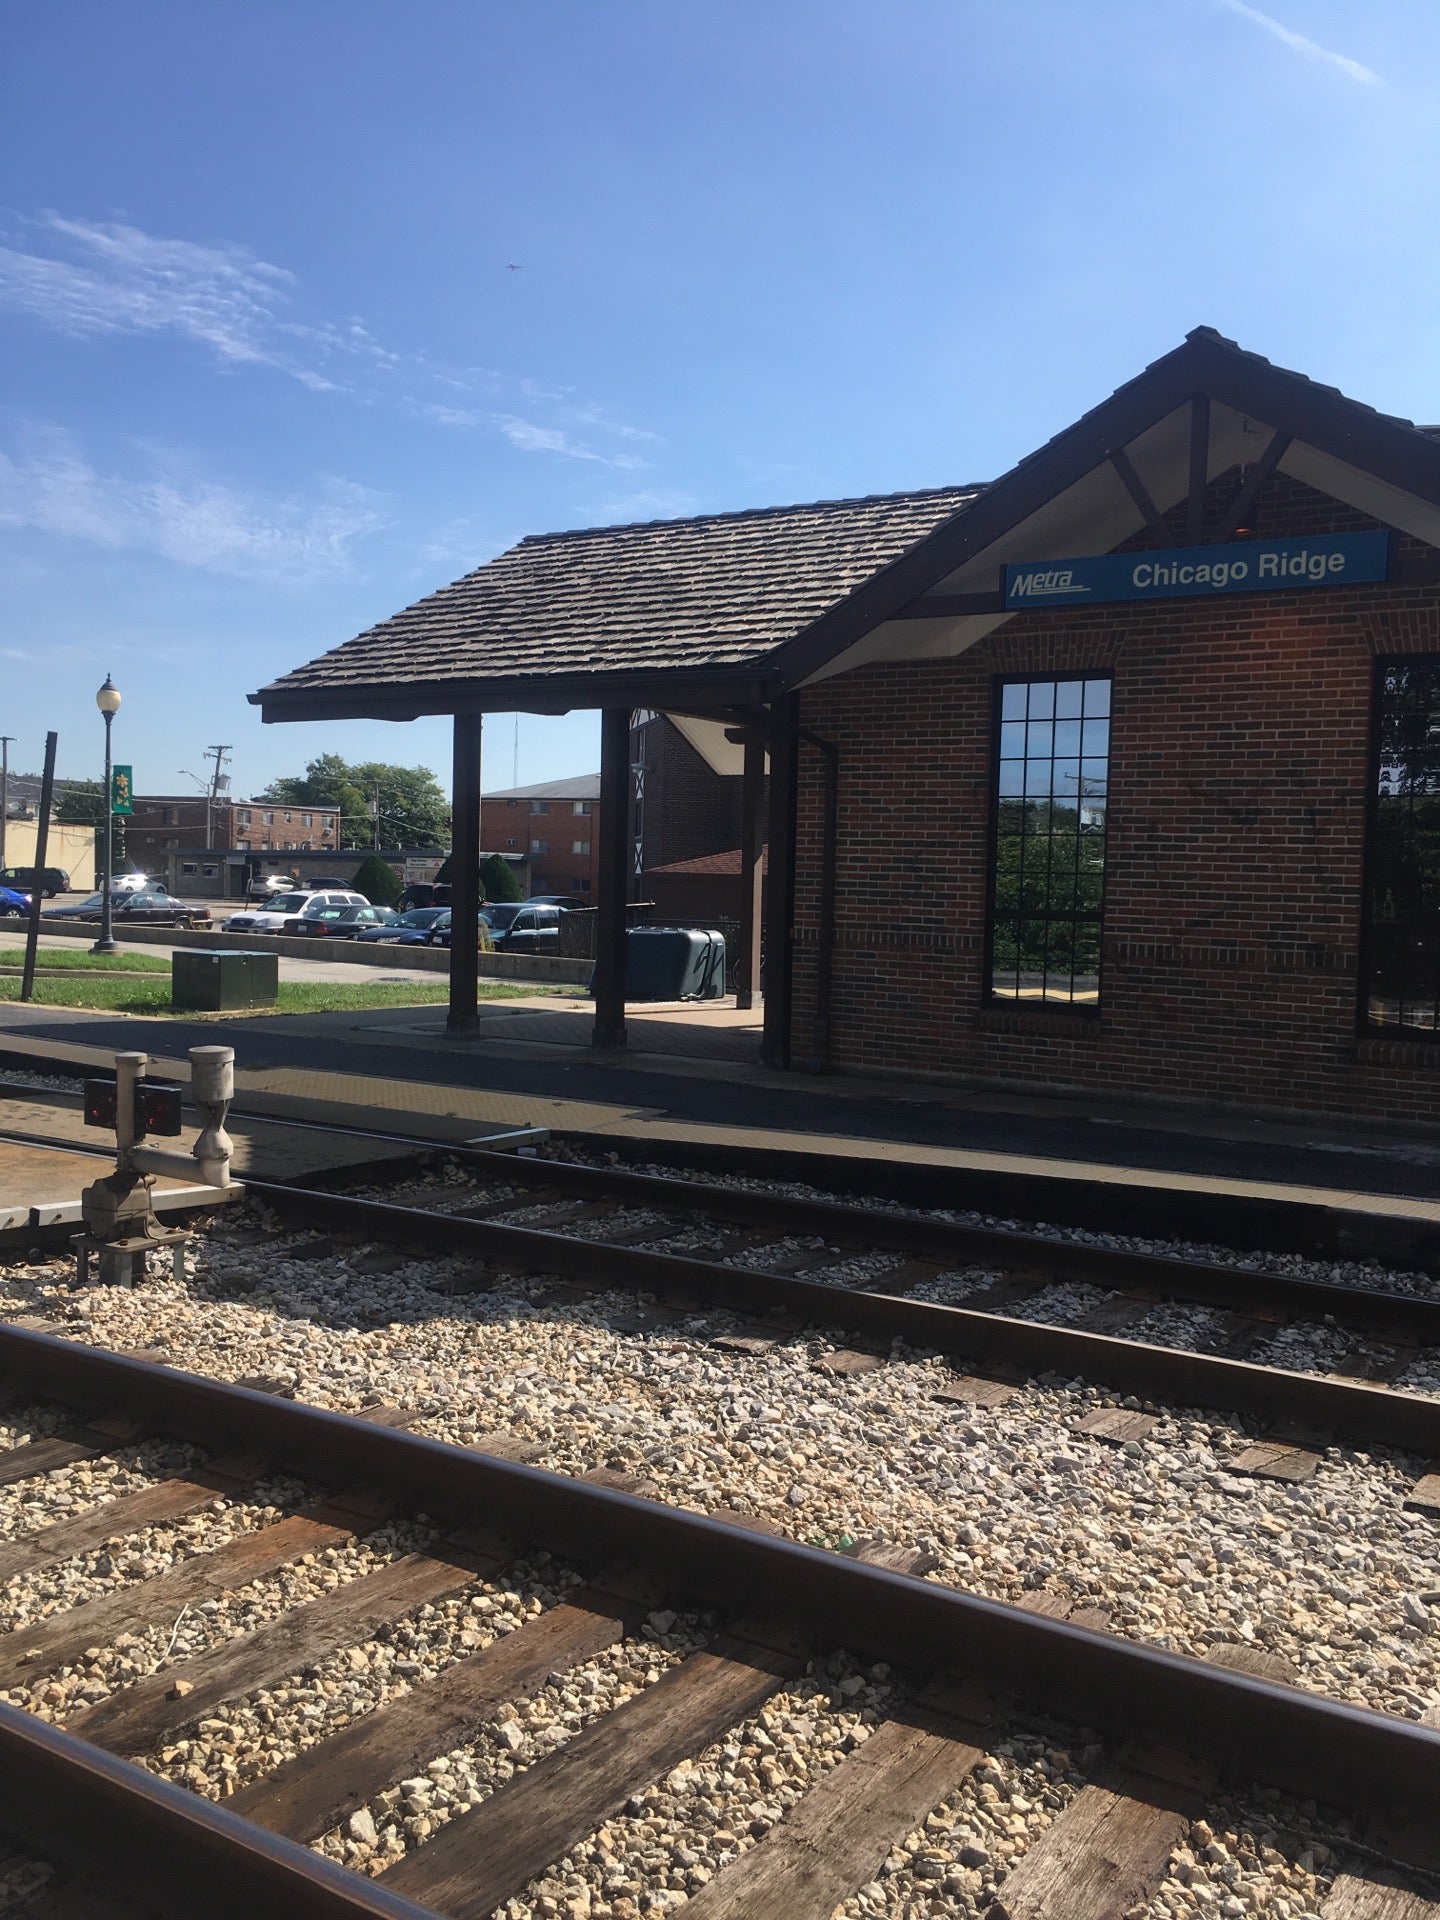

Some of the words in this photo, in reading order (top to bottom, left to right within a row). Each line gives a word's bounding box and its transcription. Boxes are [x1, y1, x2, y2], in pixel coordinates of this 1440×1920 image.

[1009, 570, 1074, 597] Metra
[1132, 561, 1248, 588] Chicago
[1258, 550, 1346, 580] Ridge
